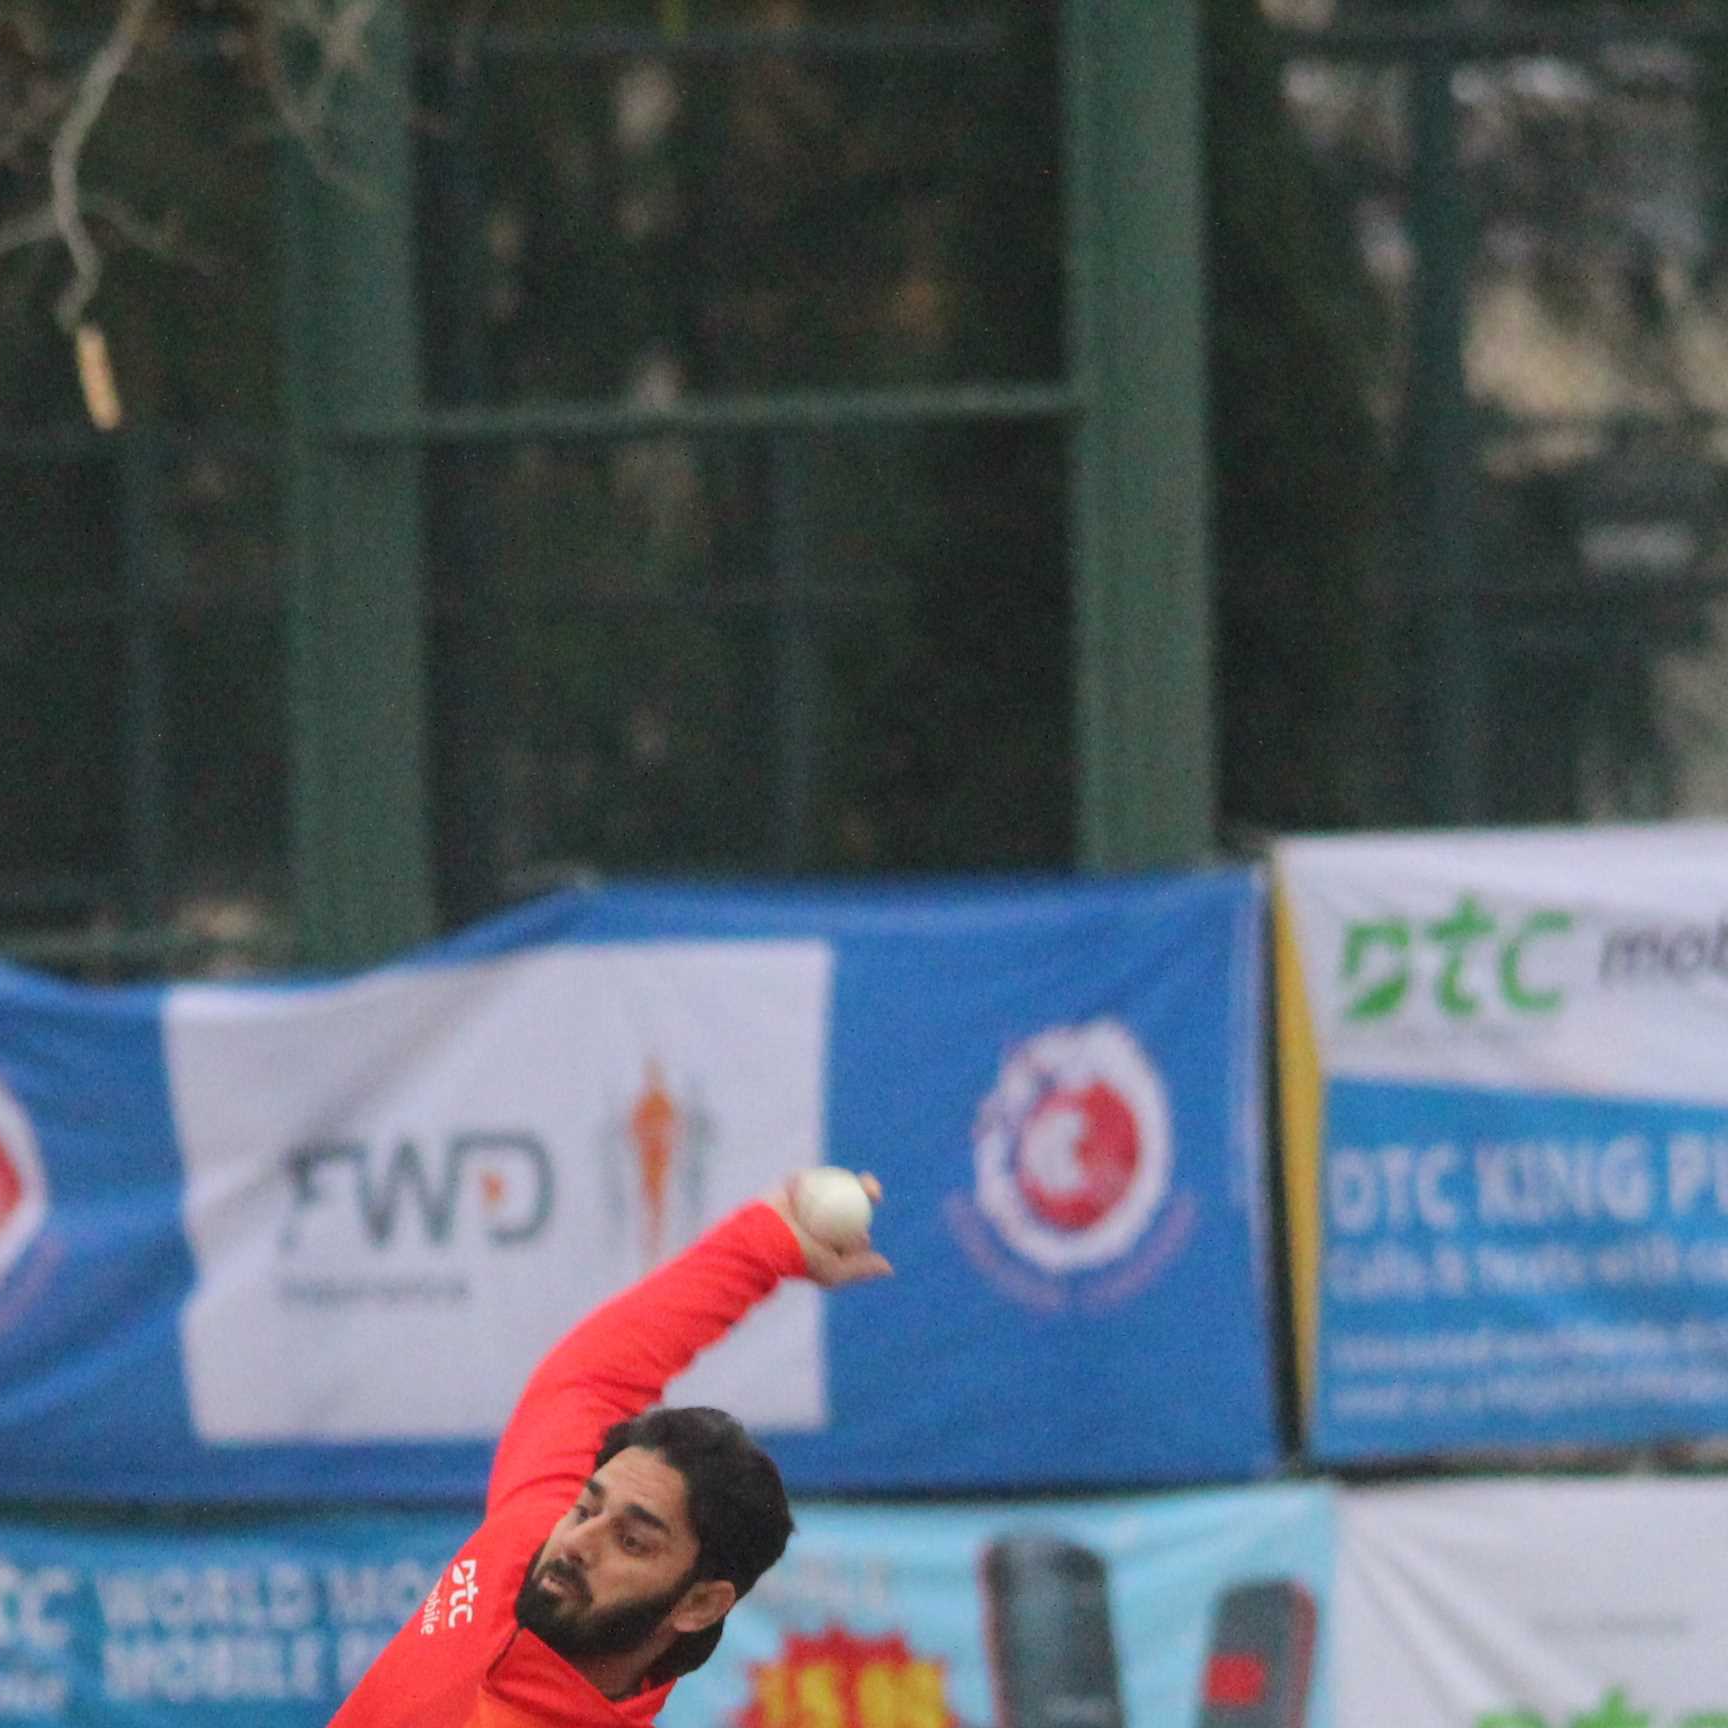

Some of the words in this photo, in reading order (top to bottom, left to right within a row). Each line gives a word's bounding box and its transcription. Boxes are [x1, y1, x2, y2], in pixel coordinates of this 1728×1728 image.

[1330, 1142, 1462, 1236] DTC
[1475, 1130, 1652, 1226] KING
[97, 1563, 319, 1630] WORLD
[101, 1633, 324, 1703] MOBILE
